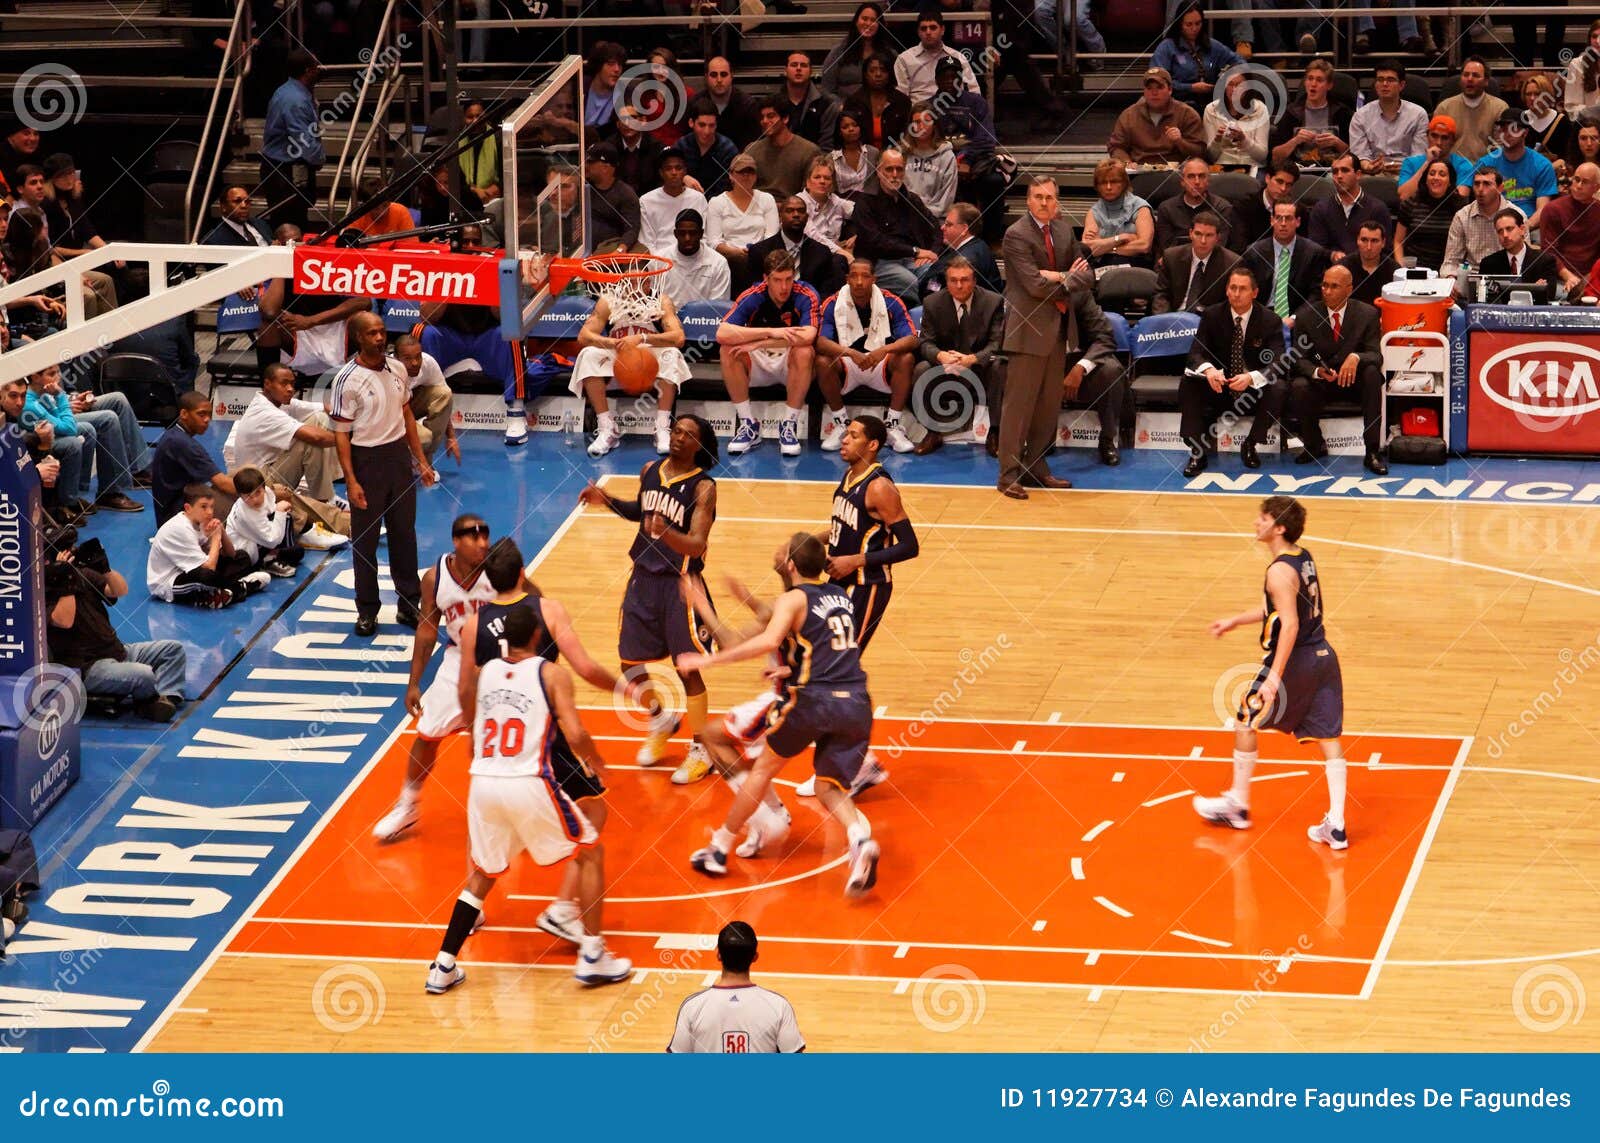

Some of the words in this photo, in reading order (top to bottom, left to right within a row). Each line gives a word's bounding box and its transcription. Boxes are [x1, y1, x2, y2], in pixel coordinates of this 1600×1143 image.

[965, 23, 983, 38] 14
[387, 306, 420, 318] Amtra
[1506, 359, 1600, 399] KIA
[641, 489, 685, 528] NDIANA
[482, 717, 526, 758] 20
[5, 795, 311, 955] YORK
[726, 1034, 746, 1053] 58
